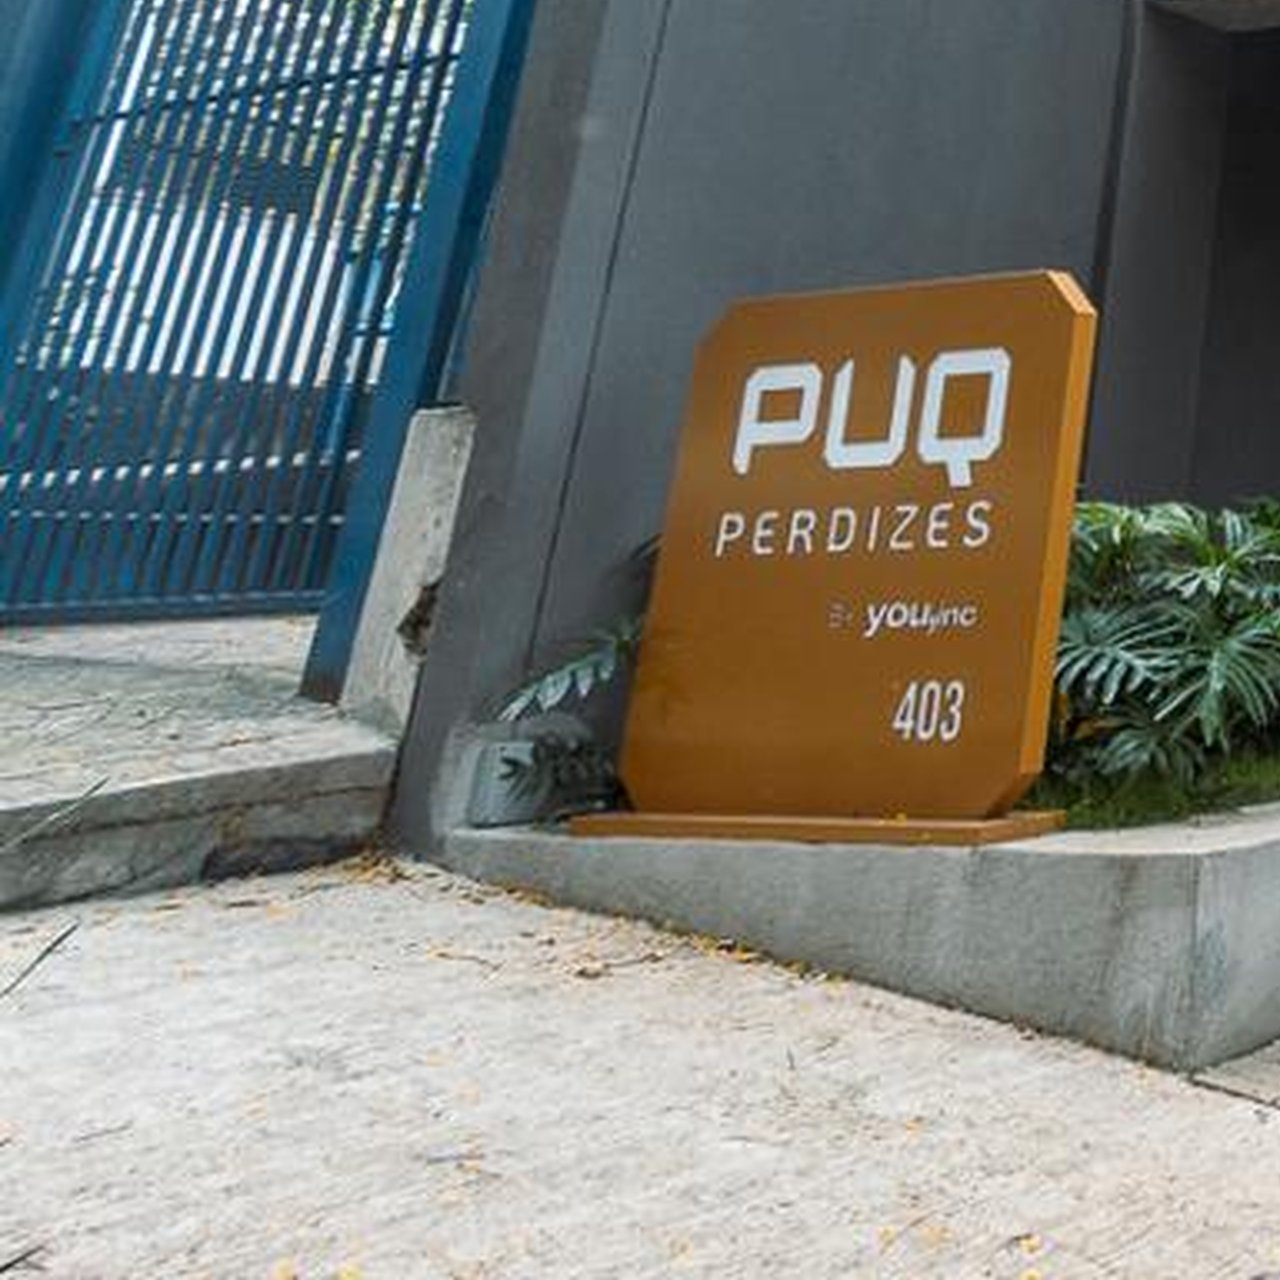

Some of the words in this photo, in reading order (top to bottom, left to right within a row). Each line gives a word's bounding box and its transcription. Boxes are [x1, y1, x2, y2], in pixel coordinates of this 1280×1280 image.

[732, 347, 1012, 487] PUQ
[714, 500, 993, 557] PERDIZES
[892, 680, 965, 742] 403
